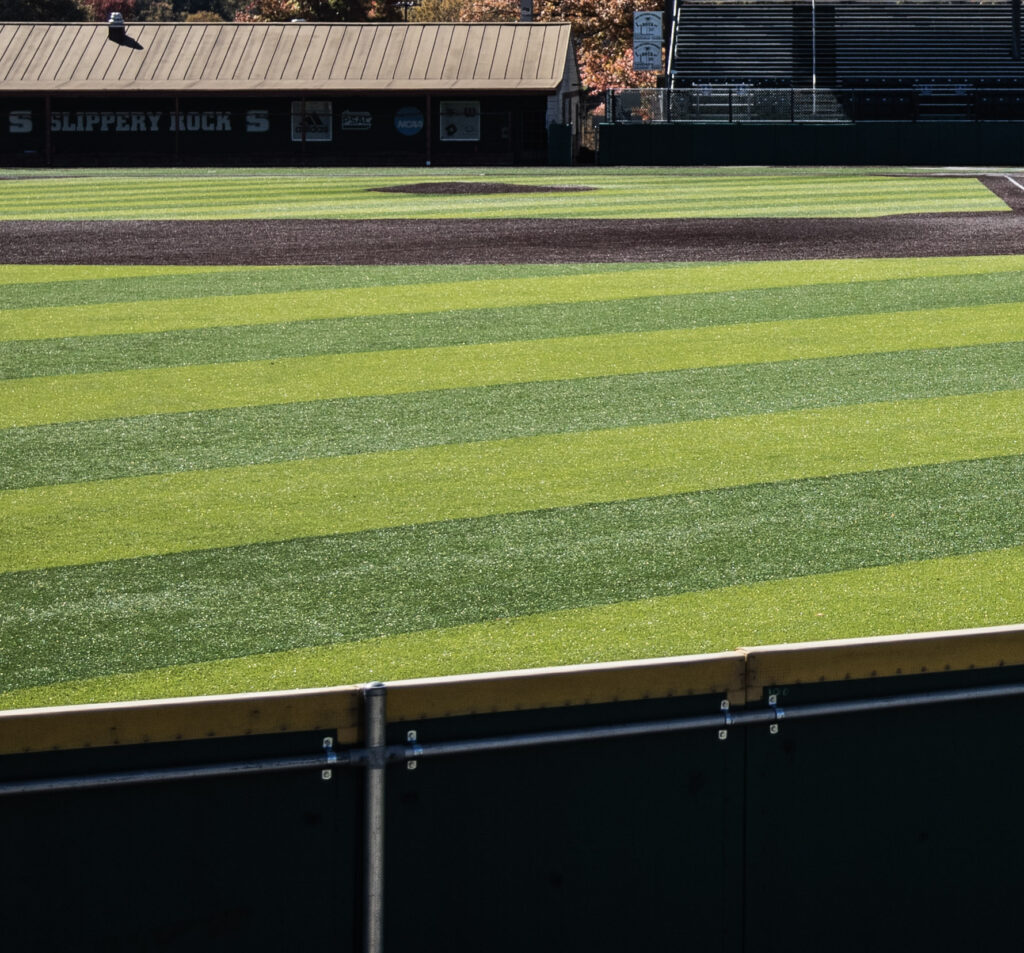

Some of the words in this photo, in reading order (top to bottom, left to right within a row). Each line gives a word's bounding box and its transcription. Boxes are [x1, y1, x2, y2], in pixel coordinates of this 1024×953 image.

[8, 110, 33, 133] S
[51, 111, 162, 132] SLIPPERY
[170, 111, 232, 132] ROCK
[245, 110, 270, 133] S
[398, 120, 424, 128] NCAA
